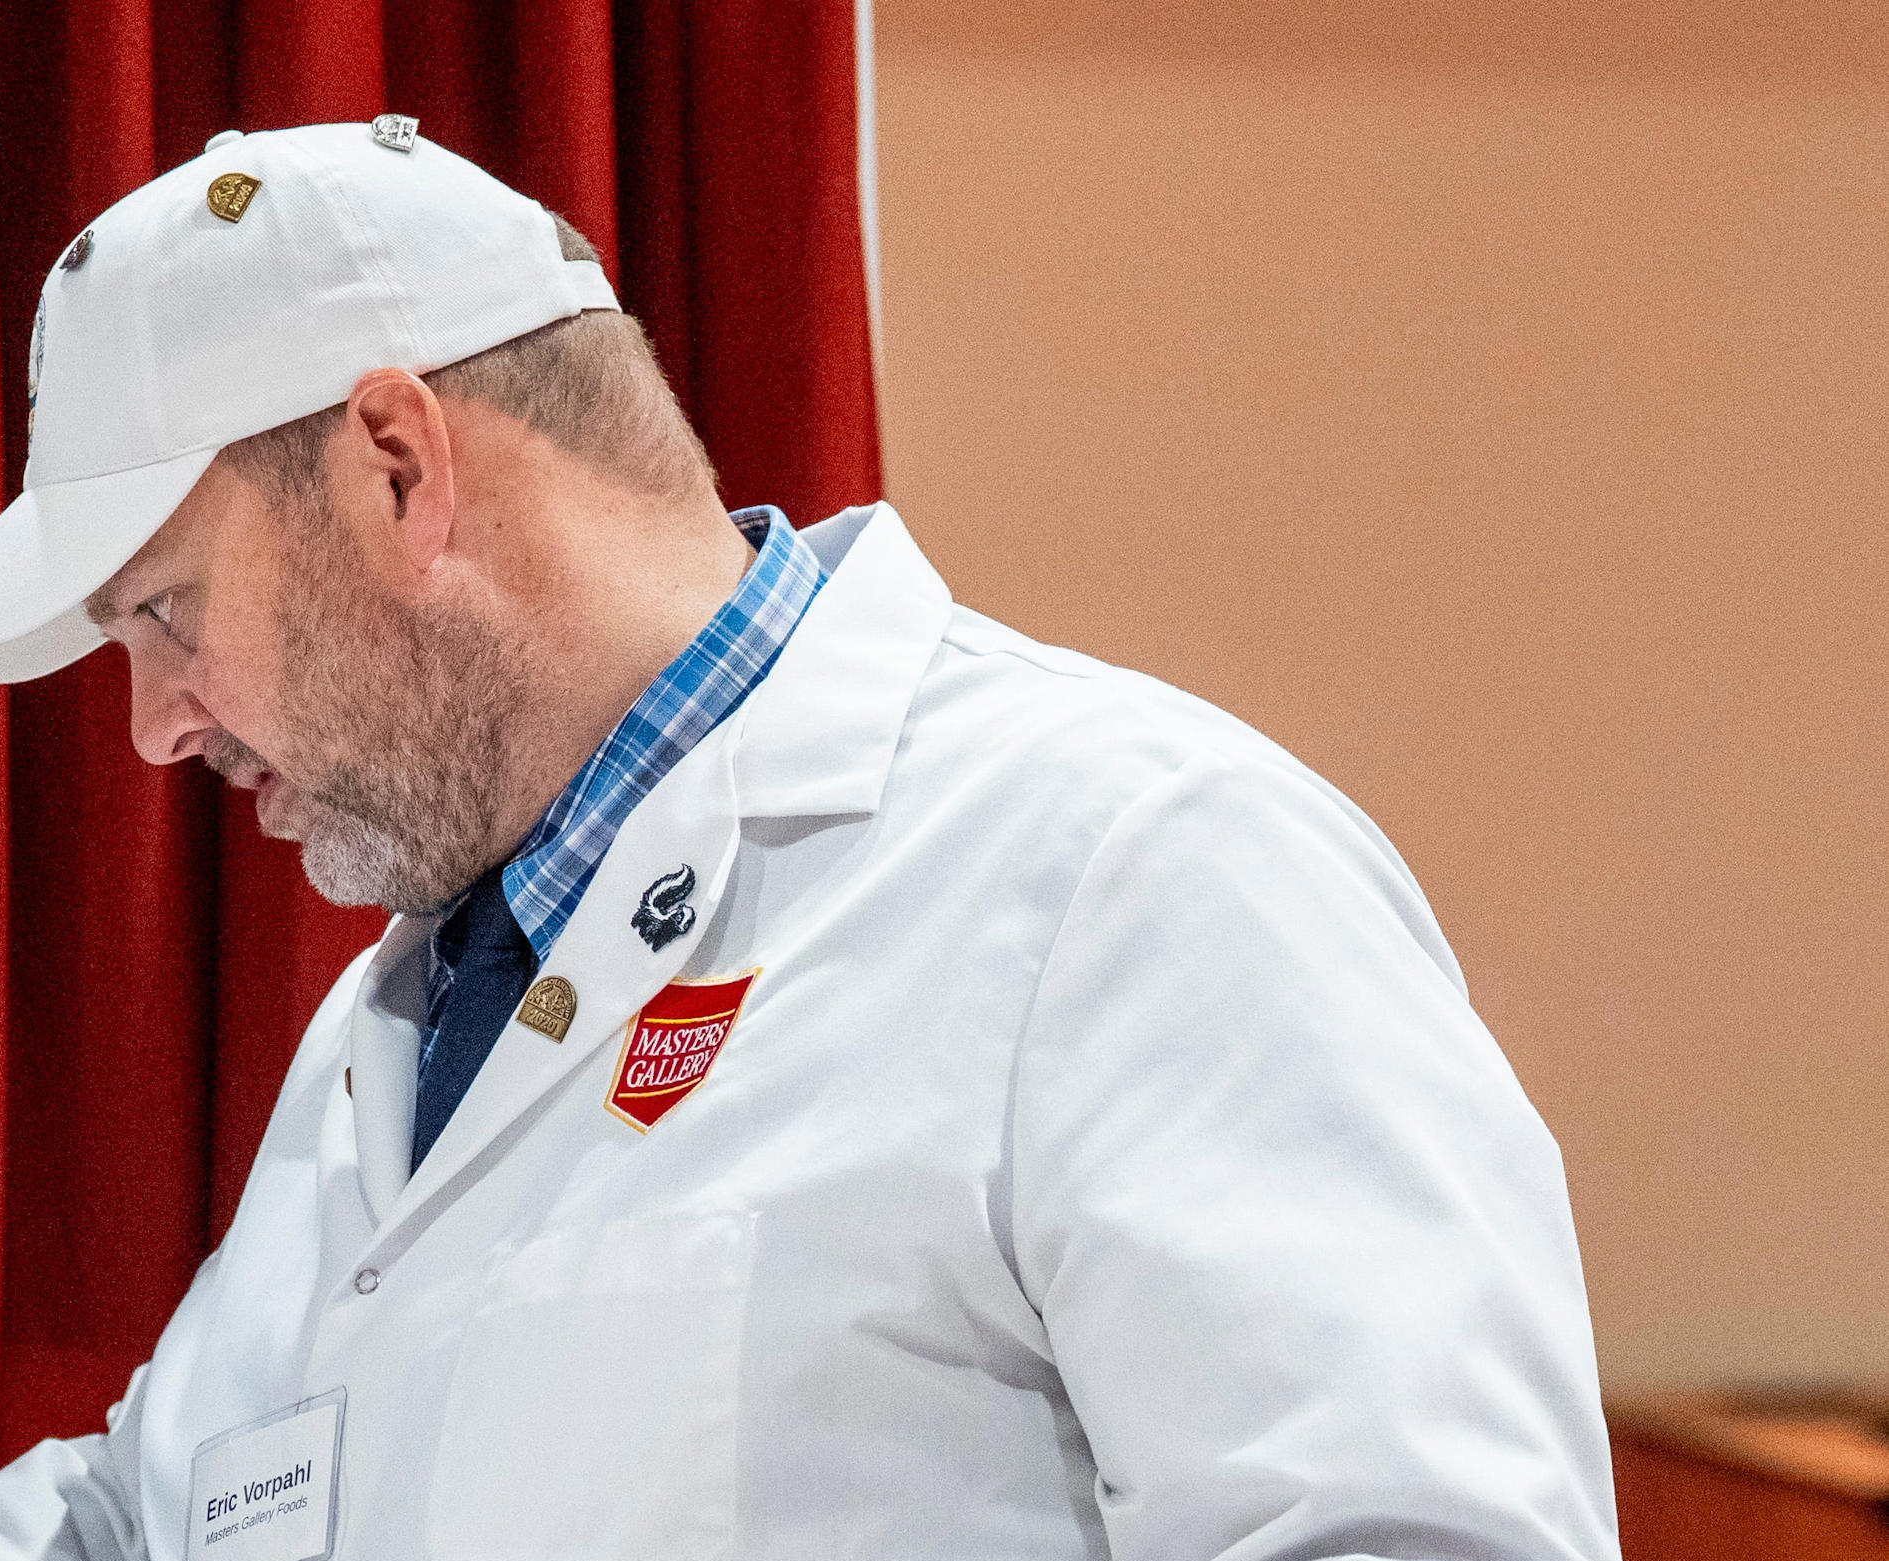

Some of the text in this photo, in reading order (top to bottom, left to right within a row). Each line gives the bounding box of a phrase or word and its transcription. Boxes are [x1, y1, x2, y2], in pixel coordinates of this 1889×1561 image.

[632, 1019, 729, 1057] MASTERS
[626, 1047, 717, 1088] GALLERY
[206, 1459, 312, 1522] Eric Vorpahl
[205, 1496, 308, 1547] Masters Gallery Foods
